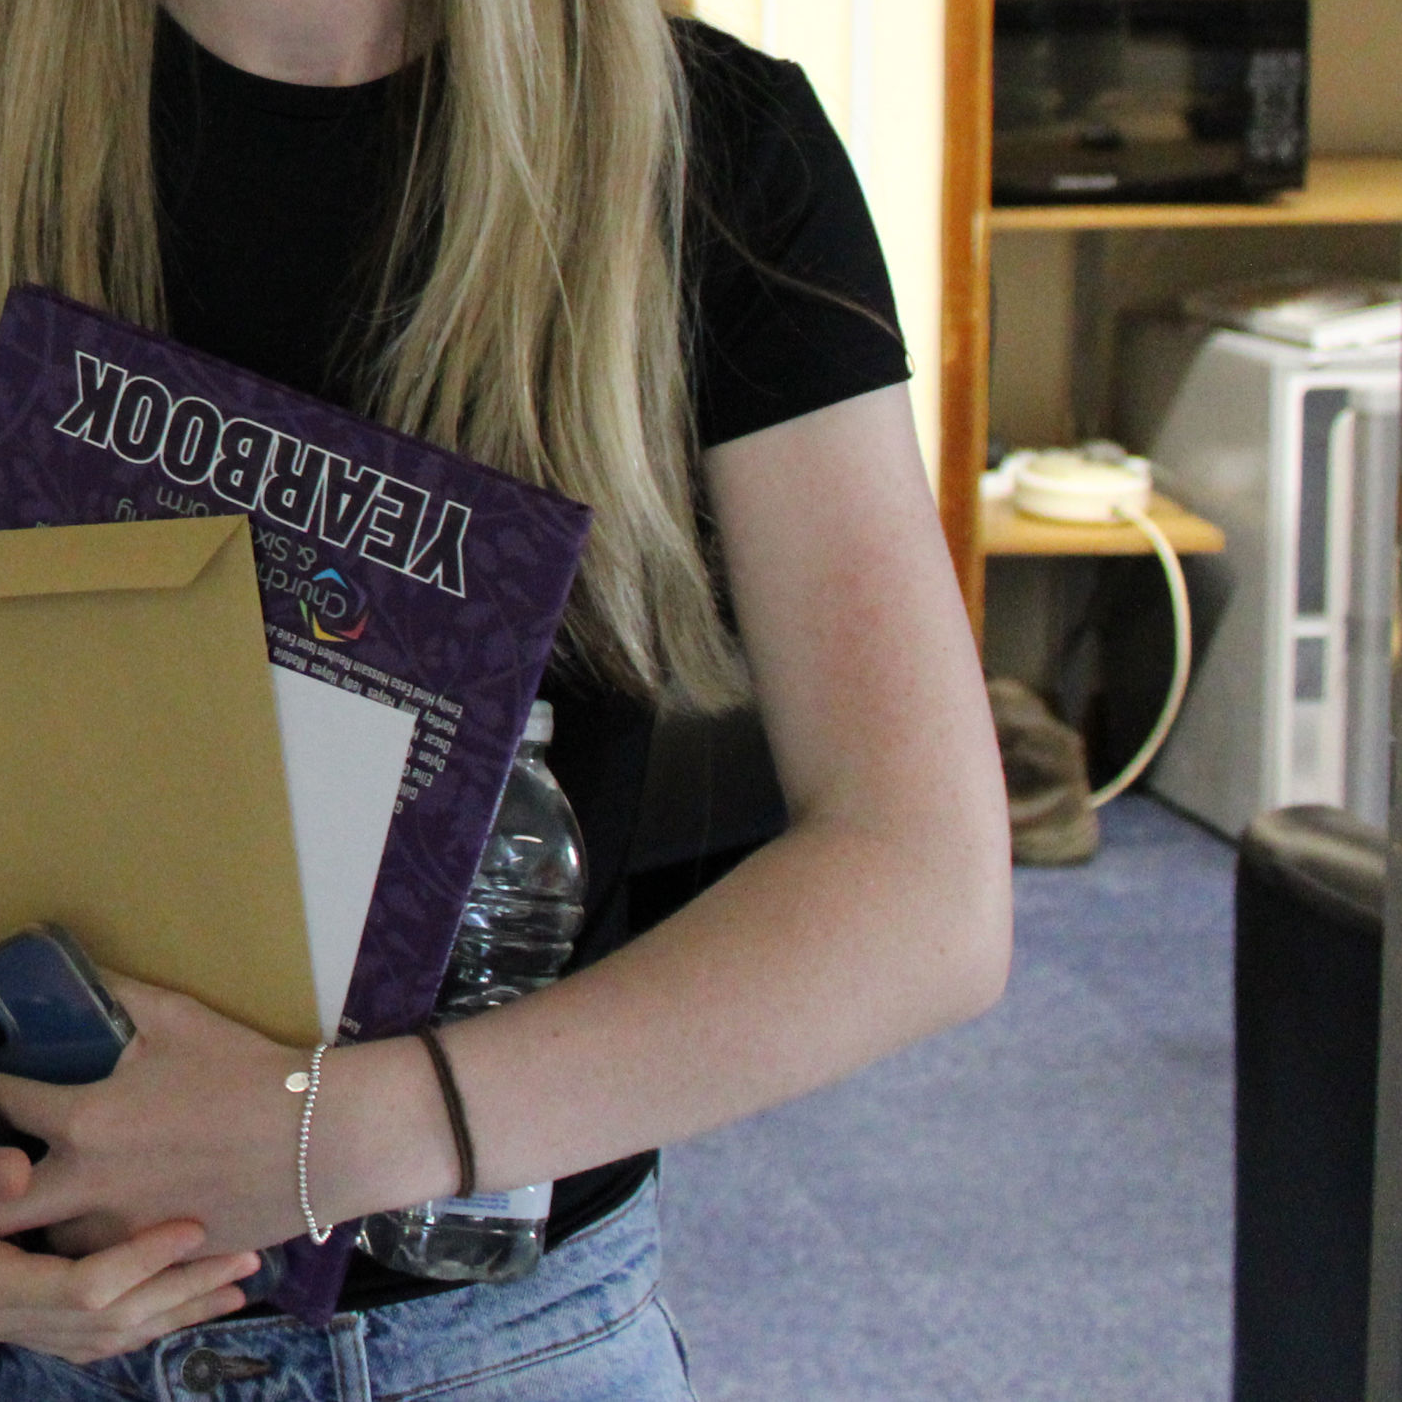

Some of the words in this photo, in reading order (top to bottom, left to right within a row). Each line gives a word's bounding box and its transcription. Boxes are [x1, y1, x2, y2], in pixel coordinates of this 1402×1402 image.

[55, 350, 471, 598] YEARBOOK
[157, 485, 212, 518] orm
[254, 529, 292, 562] Six
[295, 546, 318, 572] &
[256, 561, 347, 619] Church
[437, 694, 463, 719] Emily
[424, 732, 452, 755] Oscar
[418, 750, 446, 773] Dylan
